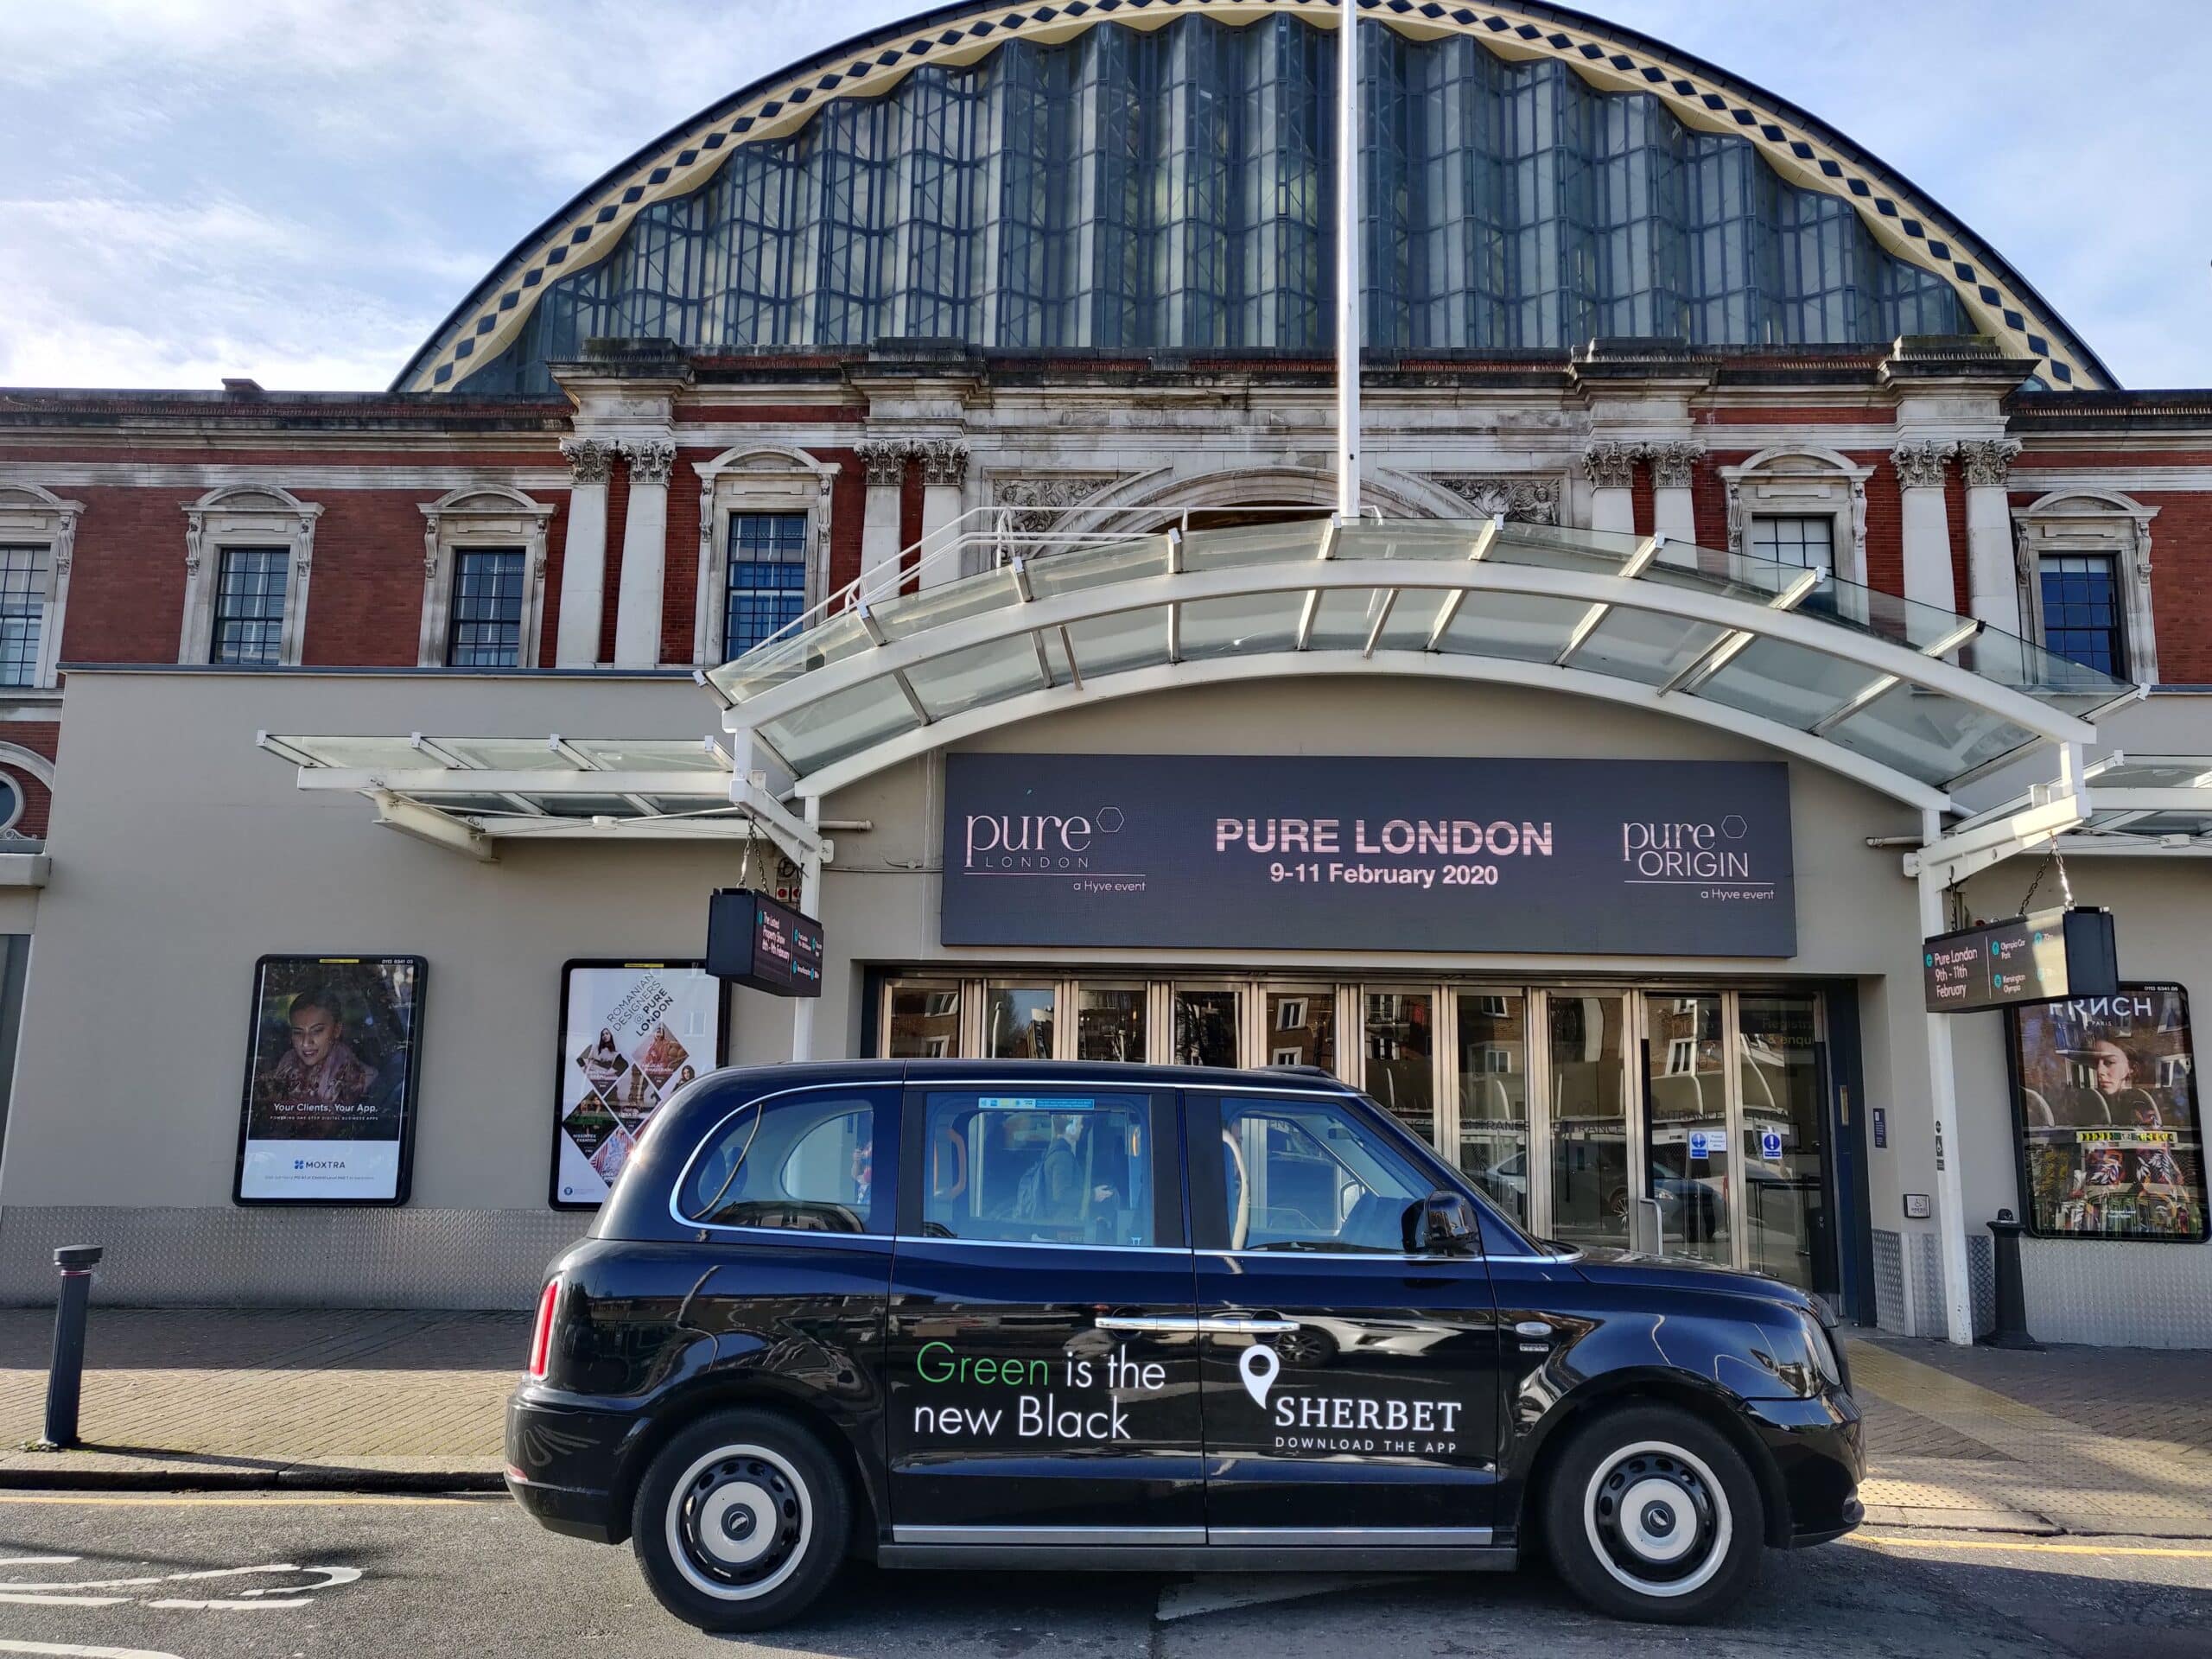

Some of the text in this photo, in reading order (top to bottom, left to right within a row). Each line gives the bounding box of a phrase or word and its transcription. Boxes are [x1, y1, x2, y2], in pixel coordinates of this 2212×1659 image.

[963, 814, 1092, 868] pure
[1215, 817, 1554, 857] PURE LONDON
[1621, 822, 1716, 862] pure
[985, 856, 1090, 869] LONDON
[1269, 862, 1500, 890] 9-11 February 2020
[1637, 850, 1750, 879] ORIGIN
[1072, 880, 1147, 893] a Hyve event
[1700, 888, 1776, 901] a Hyve event
[1934, 946, 1978, 966] Pure London
[1935, 968, 1948, 982] 9th
[1953, 963, 1967, 979] 11th
[607, 972, 654, 1023] ROMANIAN
[642, 988, 669, 1015] PURE
[1936, 982, 1967, 999] February
[612, 980, 661, 1032] DESIGNERS
[636, 995, 675, 1037] LONDON
[273, 1103, 378, 1114] Your Clients, Your App.
[304, 1160, 346, 1169] MOXTRA
[916, 1341, 1166, 1390] Green is the
[913, 1392, 1133, 1440] new Black
[1274, 1395, 1462, 1433] SHERBET
[1274, 1436, 1458, 1455] DOWNLOAD THE APP
